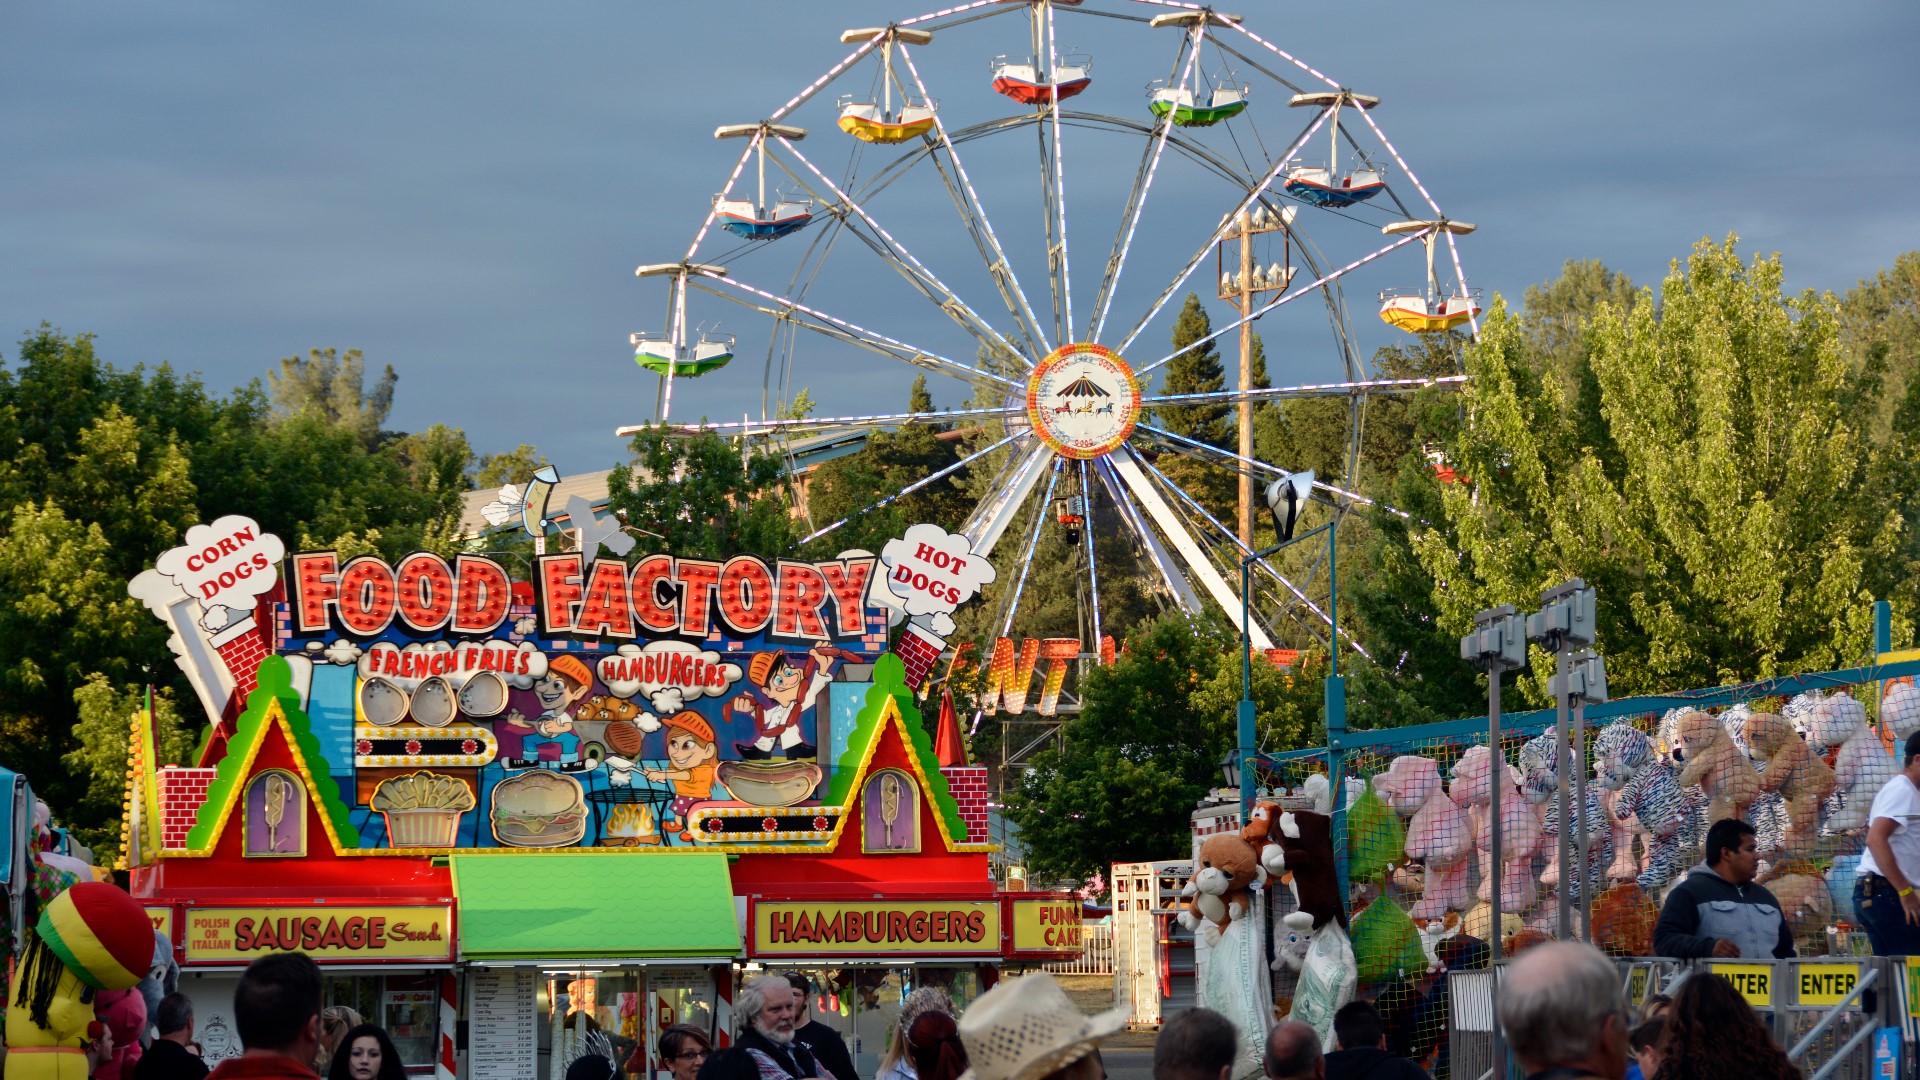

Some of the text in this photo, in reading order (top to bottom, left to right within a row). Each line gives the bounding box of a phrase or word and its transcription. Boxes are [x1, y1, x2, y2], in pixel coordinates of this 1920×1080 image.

[187, 526, 255, 572] CORN
[914, 542, 967, 576] HOT
[199, 553, 268, 600] DOGS
[892, 564, 961, 606] DOGS
[291, 551, 875, 640] FOOD FACTORY
[369, 647, 530, 680] FRENCH FRIES
[603, 651, 727, 689] HAMBURGERS
[194, 918, 230, 929] POLISH
[204, 929, 218, 939] OR
[235, 915, 387, 951] SAUSAGE
[771, 910, 985, 943] HAMBURGERS
[1044, 927, 1081, 946] CAKE
[192, 940, 231, 950] ITALIAN
[1712, 973, 1768, 994] NTER
[1801, 974, 1856, 995] ENTER
